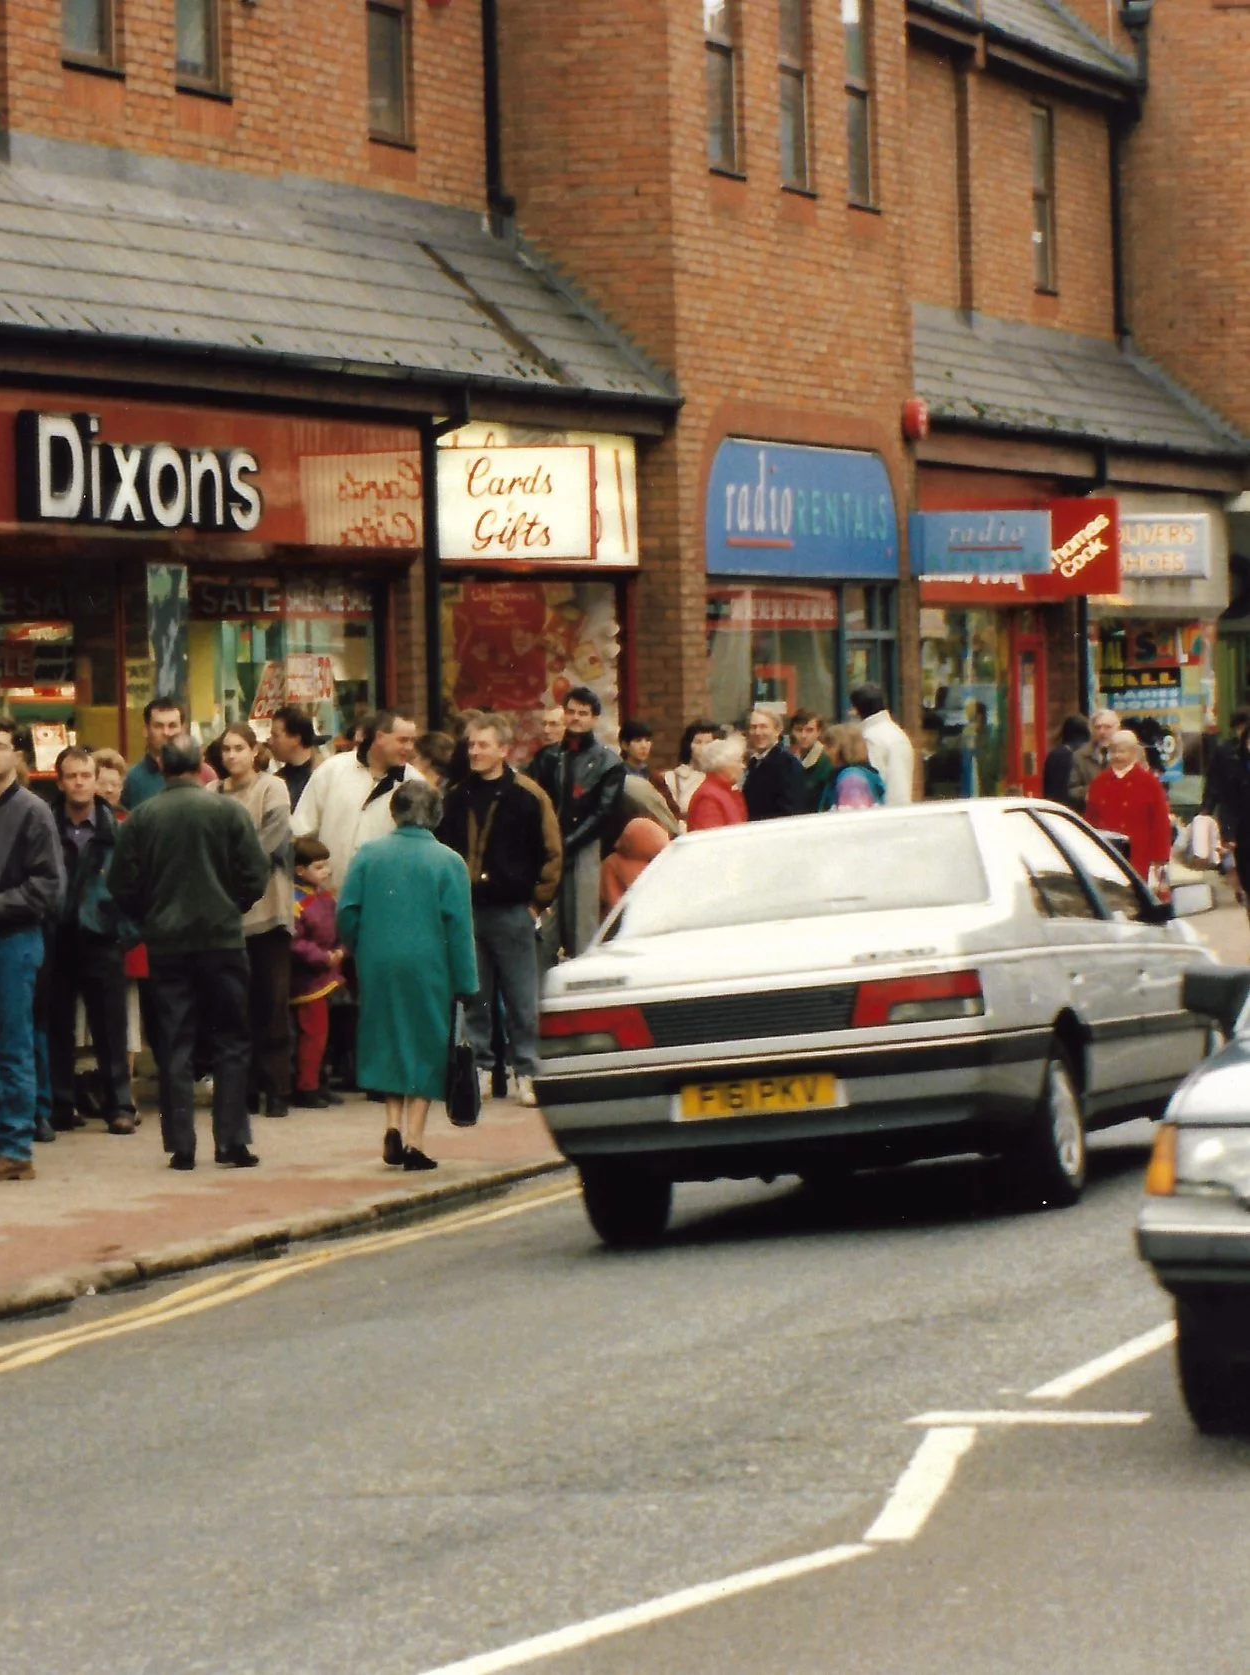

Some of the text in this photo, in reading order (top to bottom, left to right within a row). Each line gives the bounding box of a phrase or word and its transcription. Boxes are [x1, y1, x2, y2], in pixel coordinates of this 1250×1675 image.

[38, 413, 262, 532] Dixons
[466, 456, 553, 498] Cards
[724, 450, 888, 541] radio RENTALS
[471, 509, 552, 552] Gifts
[948, 514, 1027, 545] radio
[1050, 513, 1111, 570] homas
[1118, 523, 1195, 546] LIVERS
[1060, 537, 1110, 578] Cook
[201, 584, 282, 613] SALE
